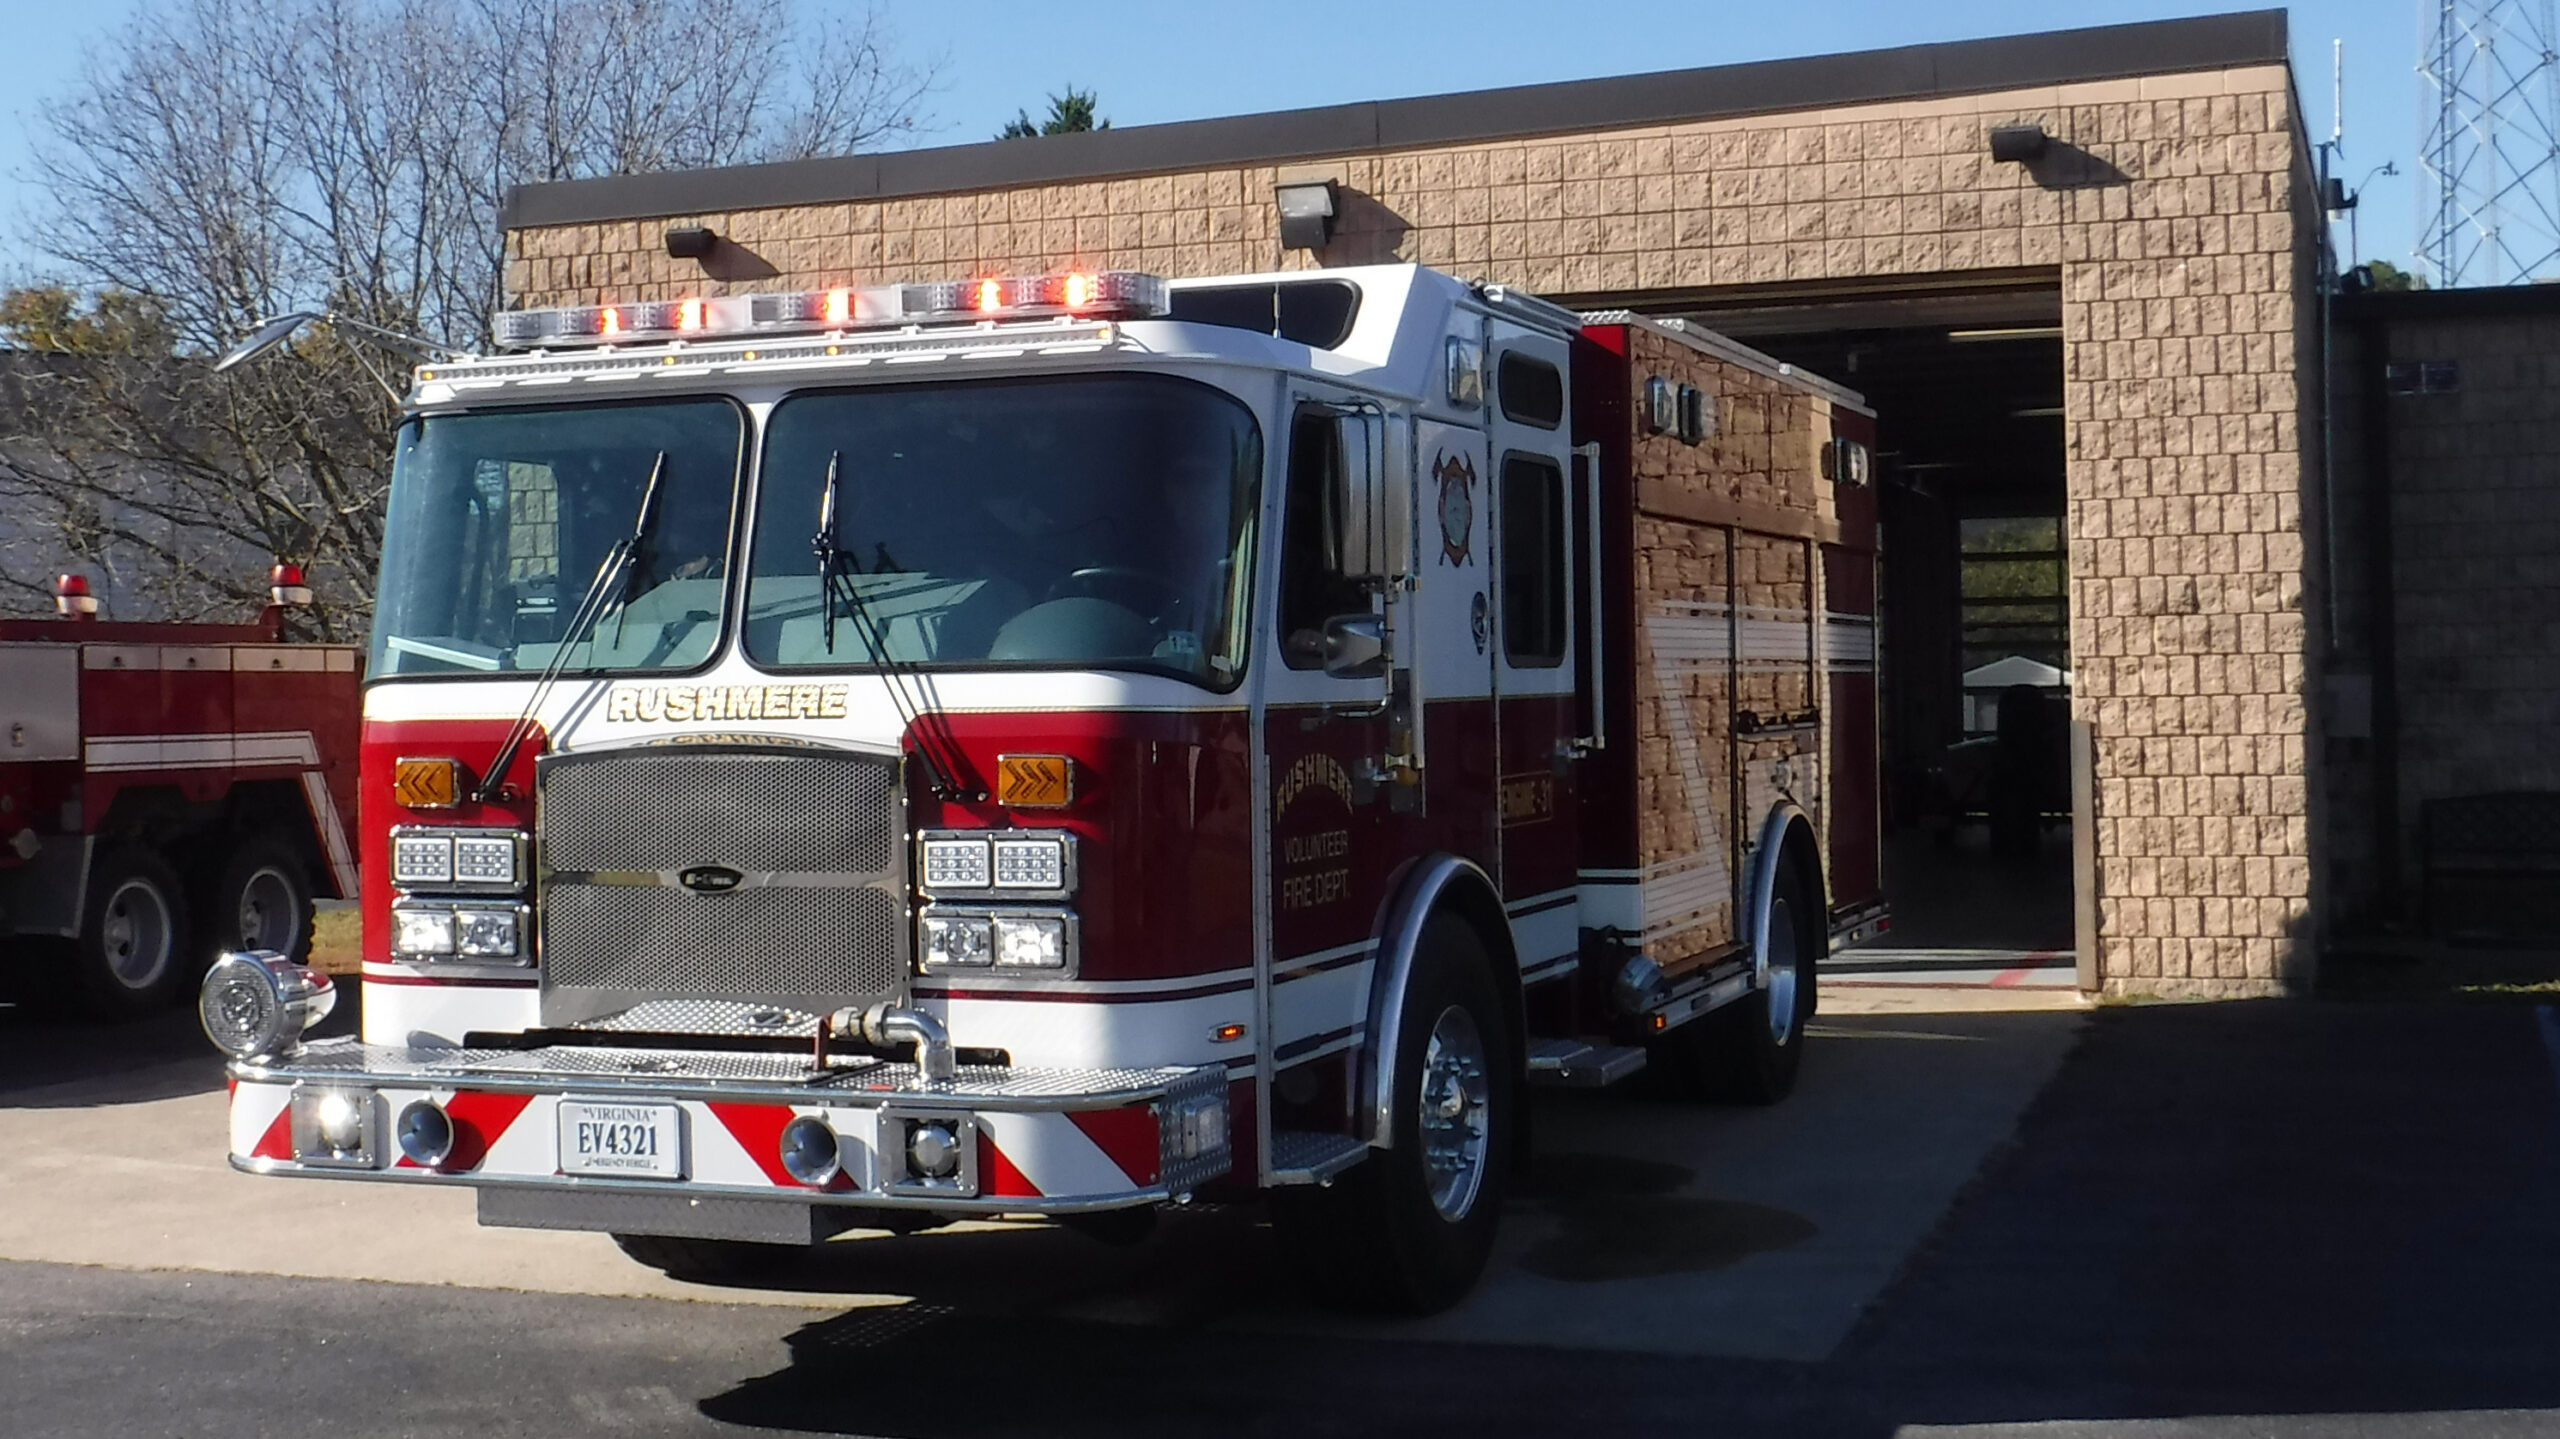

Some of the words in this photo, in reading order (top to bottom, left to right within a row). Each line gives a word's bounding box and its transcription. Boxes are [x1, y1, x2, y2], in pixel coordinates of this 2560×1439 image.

[607, 684, 849, 722] RUSHMERE
[1277, 753, 1353, 822] RUSHMERE
[1284, 830, 1348, 863] VOLUNTEER
[1283, 874, 1313, 909] FIRE
[589, 1107, 651, 1121] VIRGINIA
[578, 1122, 658, 1156] EV4321
